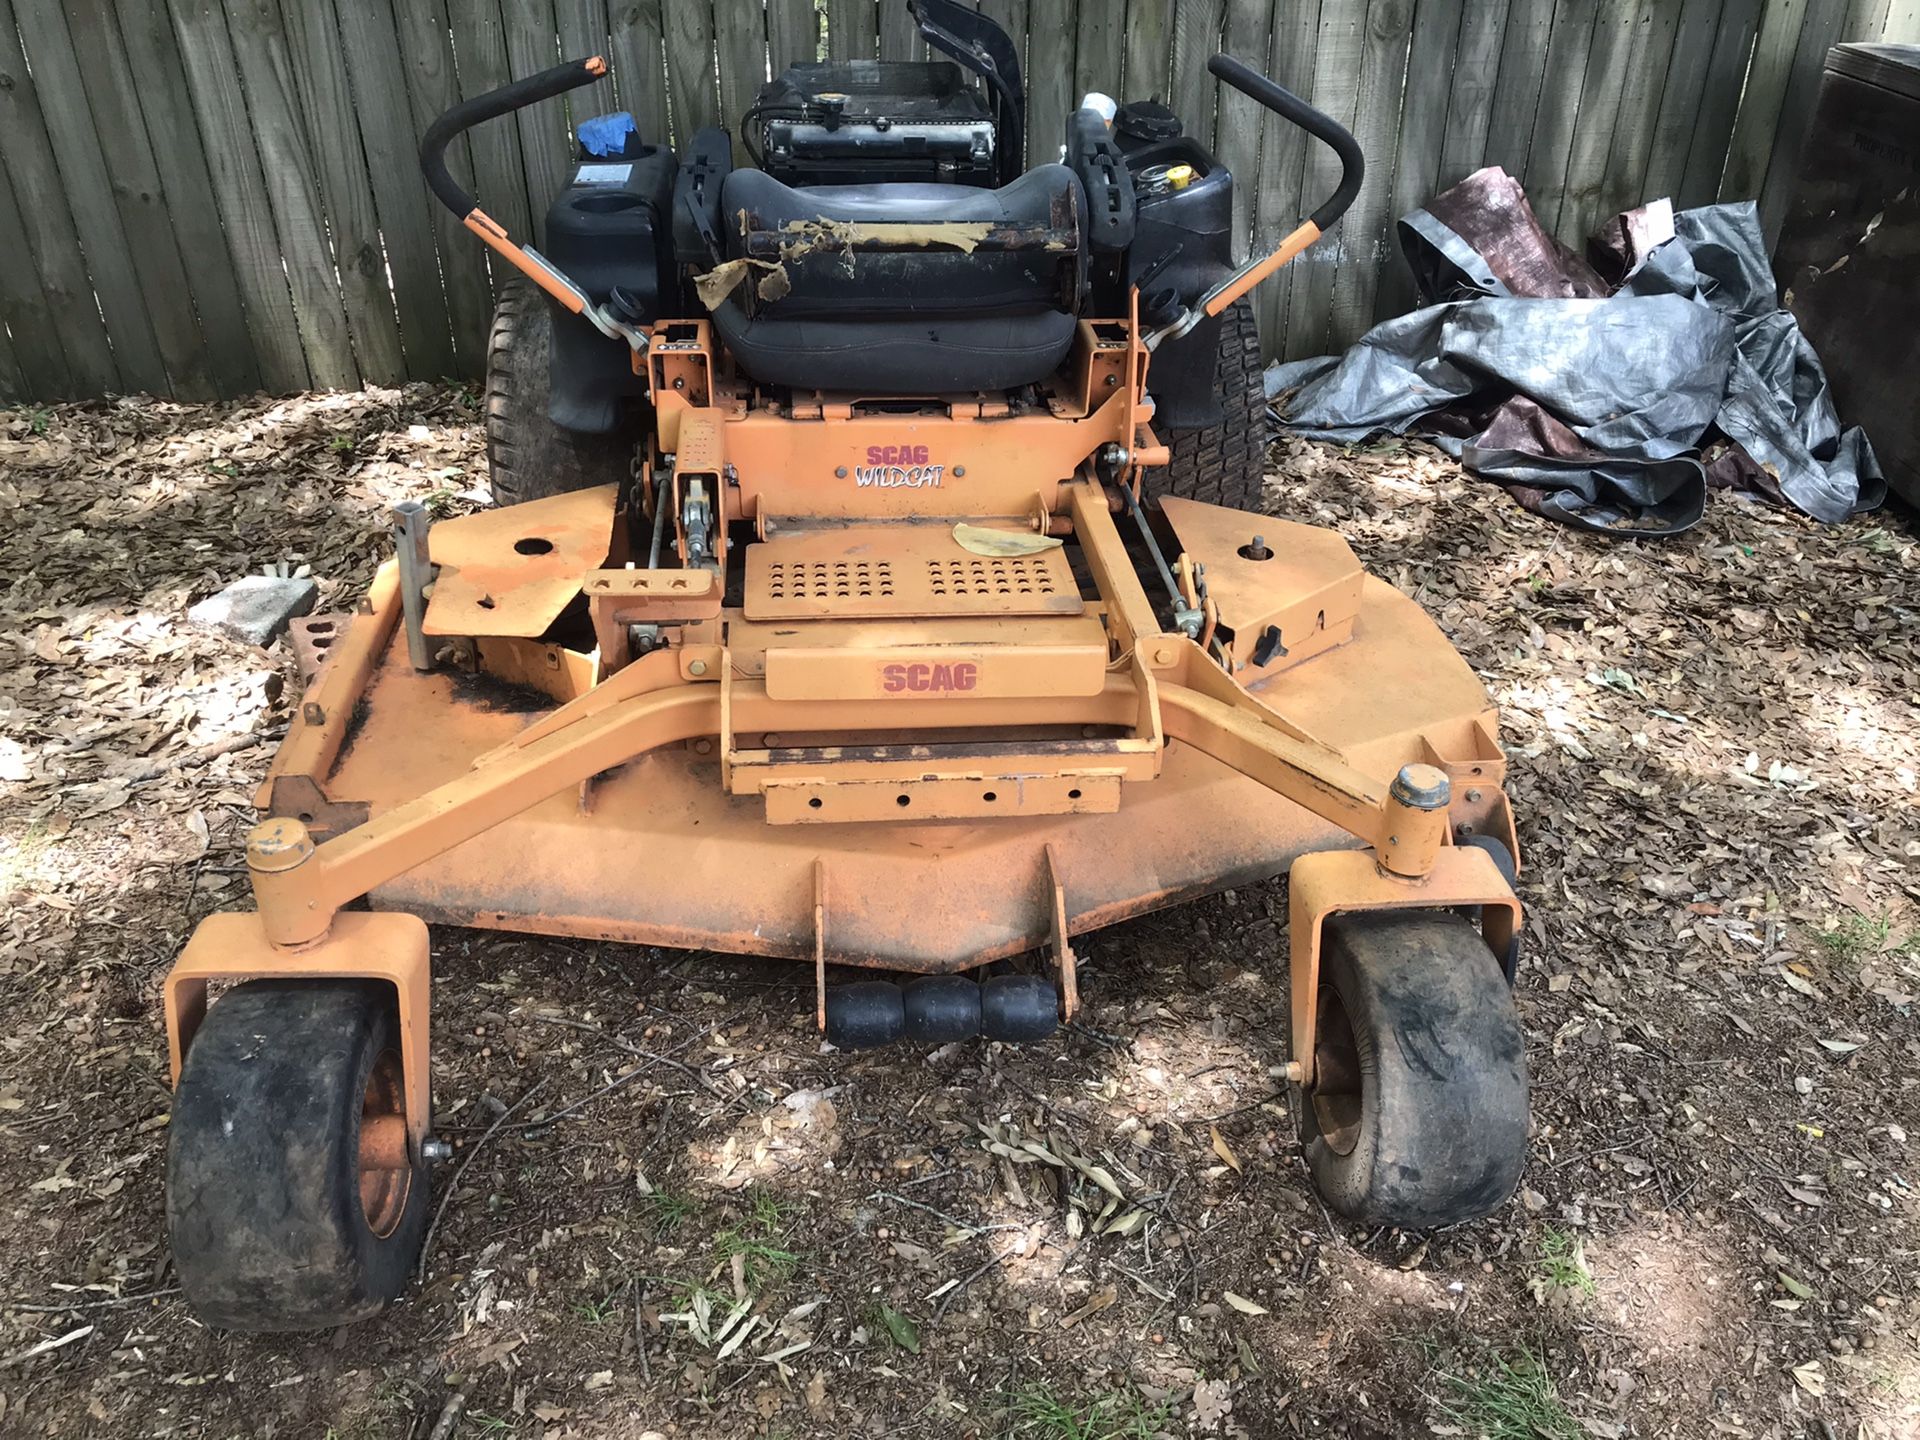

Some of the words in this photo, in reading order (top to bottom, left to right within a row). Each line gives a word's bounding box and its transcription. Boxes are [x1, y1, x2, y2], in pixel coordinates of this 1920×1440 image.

[867, 445, 929, 465] SCAG
[855, 465, 945, 488] WILDCAT
[883, 663, 977, 692] SCAG
